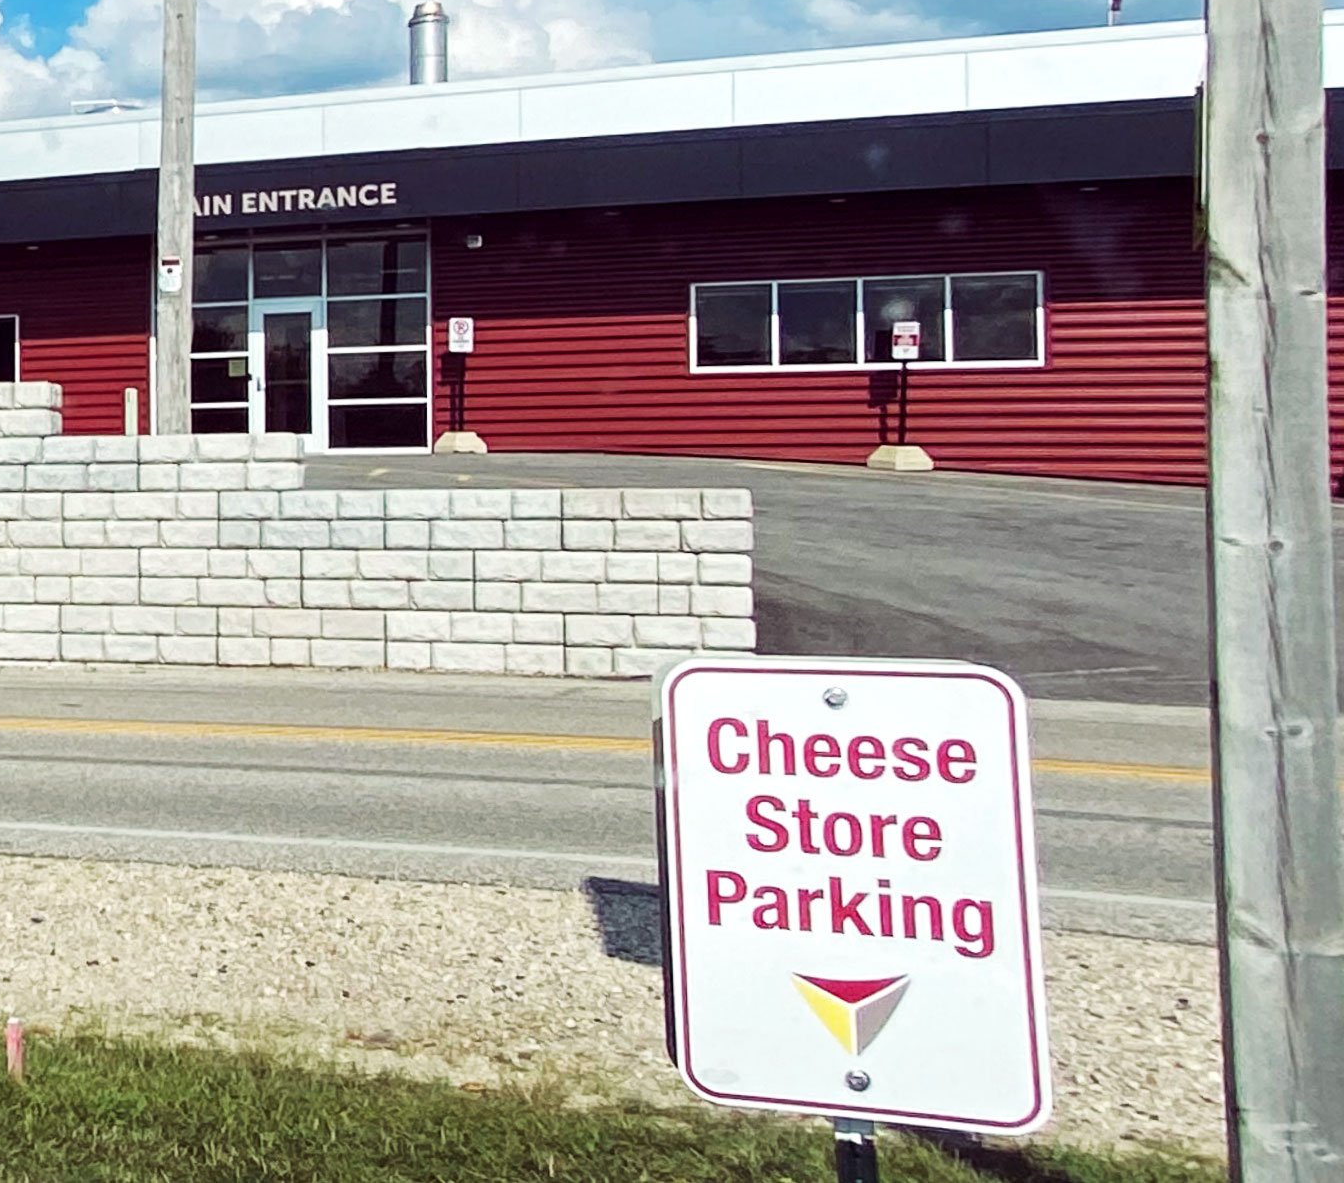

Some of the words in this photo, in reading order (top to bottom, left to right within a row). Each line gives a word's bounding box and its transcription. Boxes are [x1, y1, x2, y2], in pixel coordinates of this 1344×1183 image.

[241, 182, 397, 214] ENTRANCE
[706, 717, 977, 784] Cheese
[745, 794, 943, 861] Store
[705, 869, 996, 959] Parking
